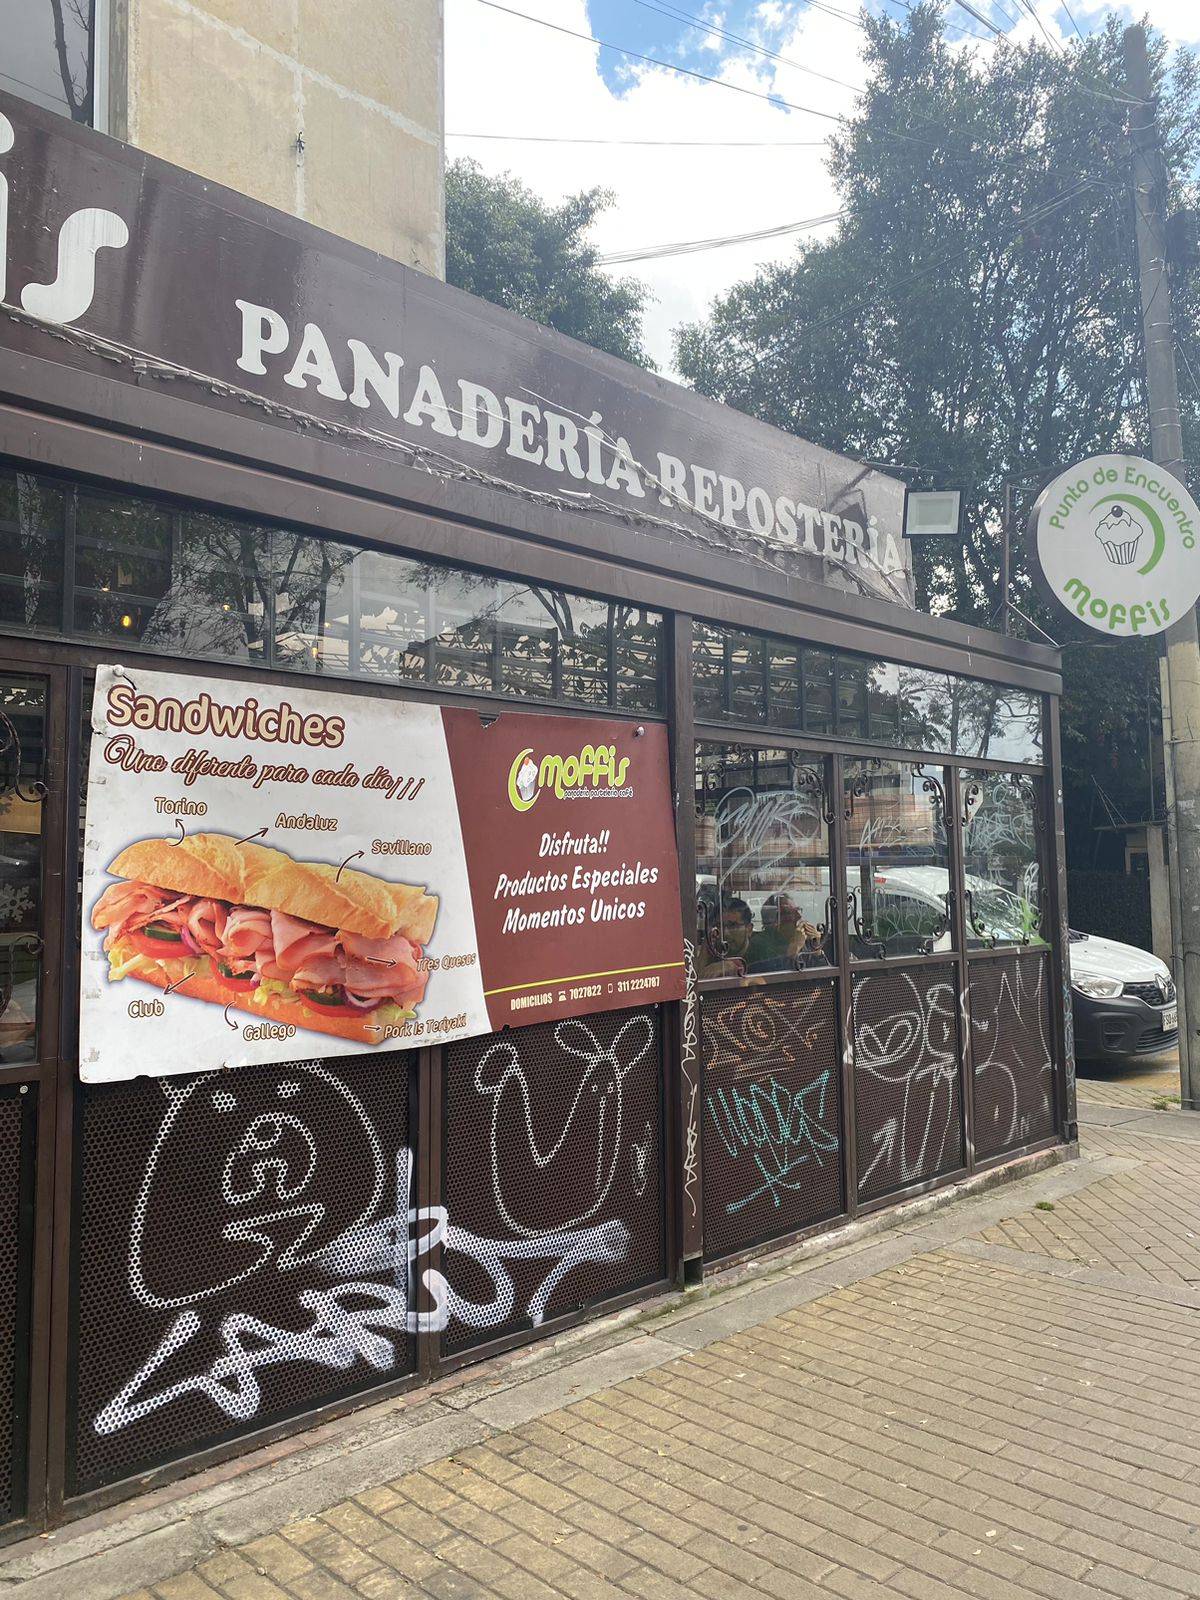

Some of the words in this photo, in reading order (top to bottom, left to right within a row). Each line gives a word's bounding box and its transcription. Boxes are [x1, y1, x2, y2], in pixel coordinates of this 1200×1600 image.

[1049, 480, 1089, 530] Punto
[1093, 467, 1118, 486] de
[1124, 466, 1195, 550] Encuentro
[106, 684, 346, 747] Sandwiches
[171, 748, 258, 787] diferente
[253, 763, 309, 789] para
[312, 763, 360, 788] cada
[155, 796, 208, 817] Torino
[275, 812, 338, 832] Andaluz
[371, 839, 432, 857] Sevillano
[538, 829, 610, 858] Disfruta!!
[494, 871, 568, 899] Productos
[571, 861, 659, 894] Especiales
[502, 904, 585, 934] Momentos
[590, 897, 646, 923] Unicos
[416, 957, 440, 972] Tres
[441, 953, 476, 970] Quesos
[128, 998, 165, 1019] Club
[510, 992, 553, 1011] DOMICILIOS
[569, 984, 602, 1001] 7027822
[242, 1023, 297, 1042] Gallego
[384, 1022, 412, 1040] Pork
[426, 1012, 467, 1034] Teriyaki
